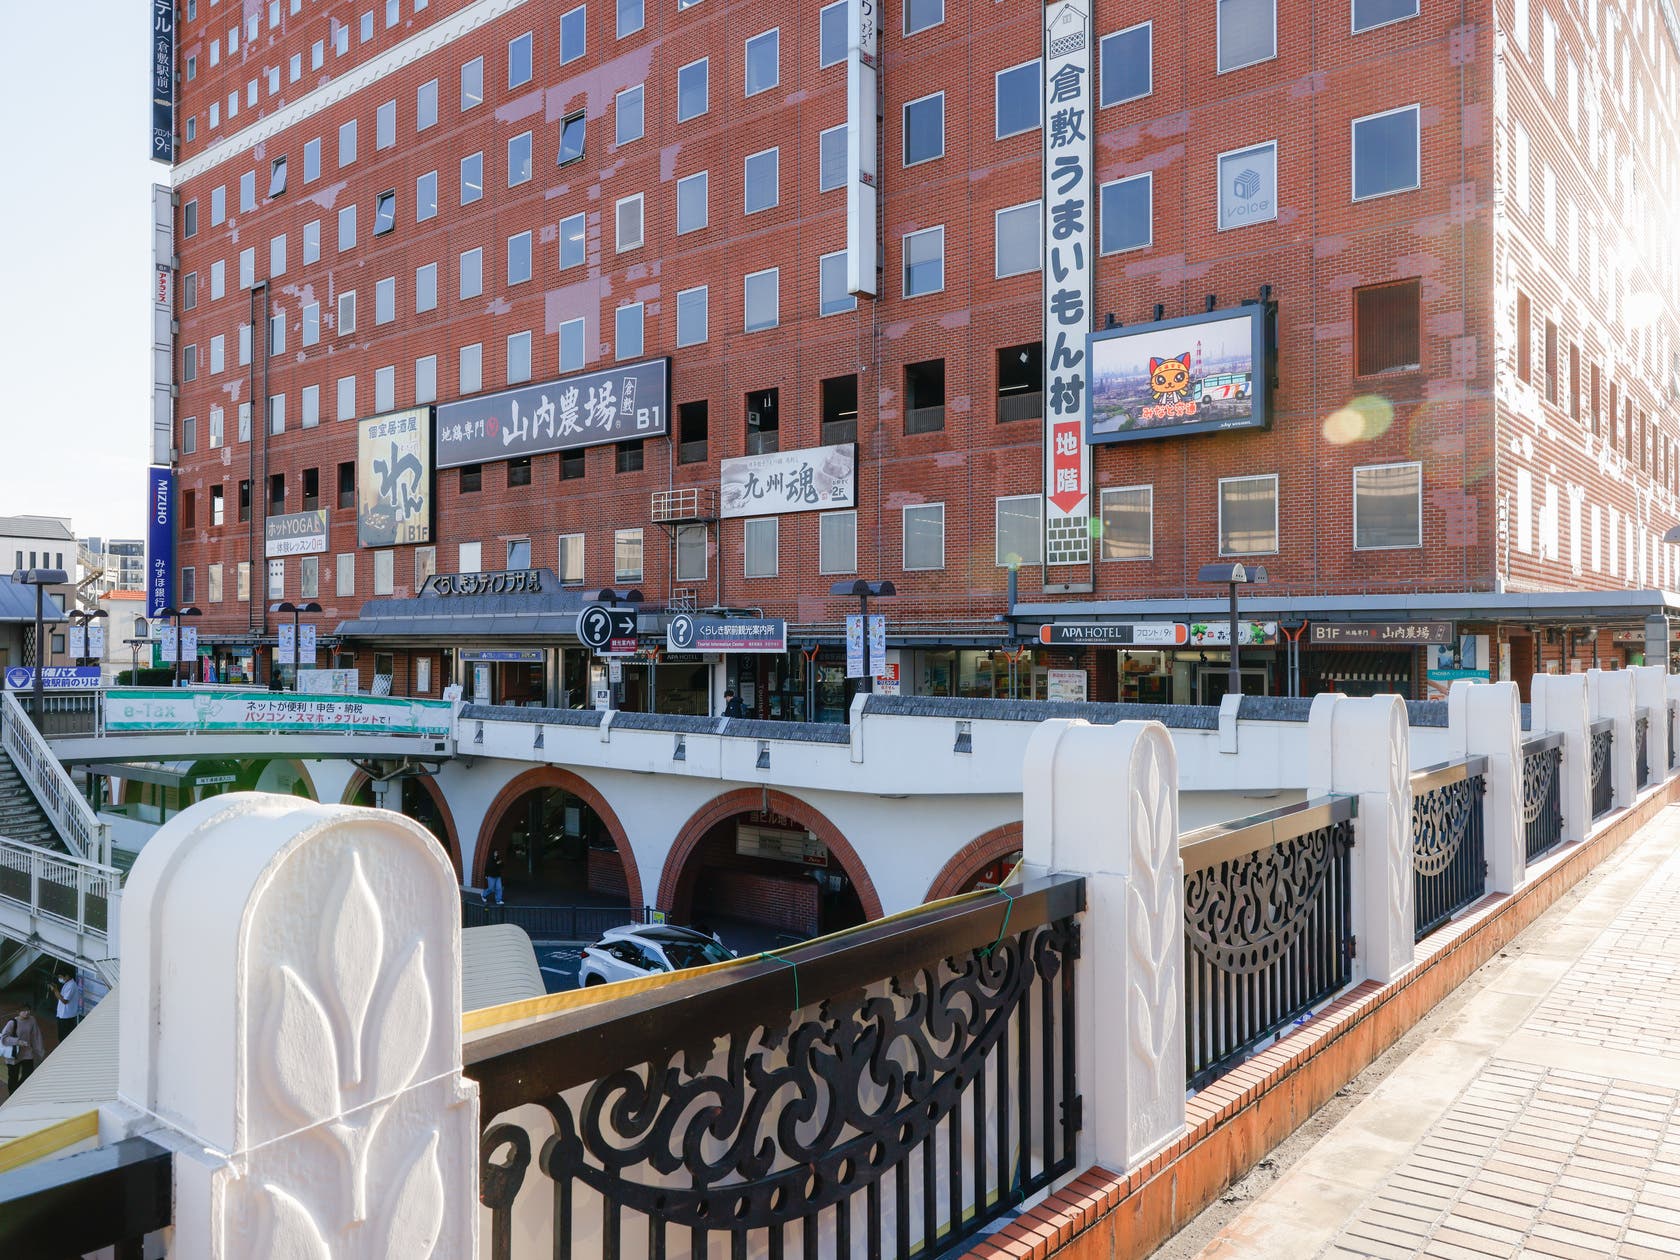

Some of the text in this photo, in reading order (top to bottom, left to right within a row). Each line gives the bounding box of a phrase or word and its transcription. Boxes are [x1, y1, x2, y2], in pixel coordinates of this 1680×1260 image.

[154, 136, 171, 153] 9F
[1049, 62, 1087, 416] 倉敷うまいもん村
[622, 380, 637, 414] 倉敷
[502, 380, 617, 447] 山内農場
[636, 406, 660, 430] B1
[368, 416, 418, 440] 個室居酒屋
[441, 418, 485, 443] 地鶏専門
[1056, 431, 1078, 494] 地階
[373, 440, 424, 520] わん
[742, 462, 819, 504] 九州魂
[831, 486, 845, 497] 2F
[157, 479, 168, 525] MIZUHO
[268, 517, 313, 537] ホットYOGA
[408, 525, 428, 542] B1F
[154, 558, 165, 608] みずほ銀行
[433, 572, 527, 595] くらしきシティプラザ
[699, 624, 775, 636] くらしき駅前観光案内所
[1062, 627, 1122, 638] APA HOTEL
[1316, 627, 1340, 639] B1F
[1382, 626, 1430, 640] 山内農場
[123, 703, 176, 719] e-Tax
